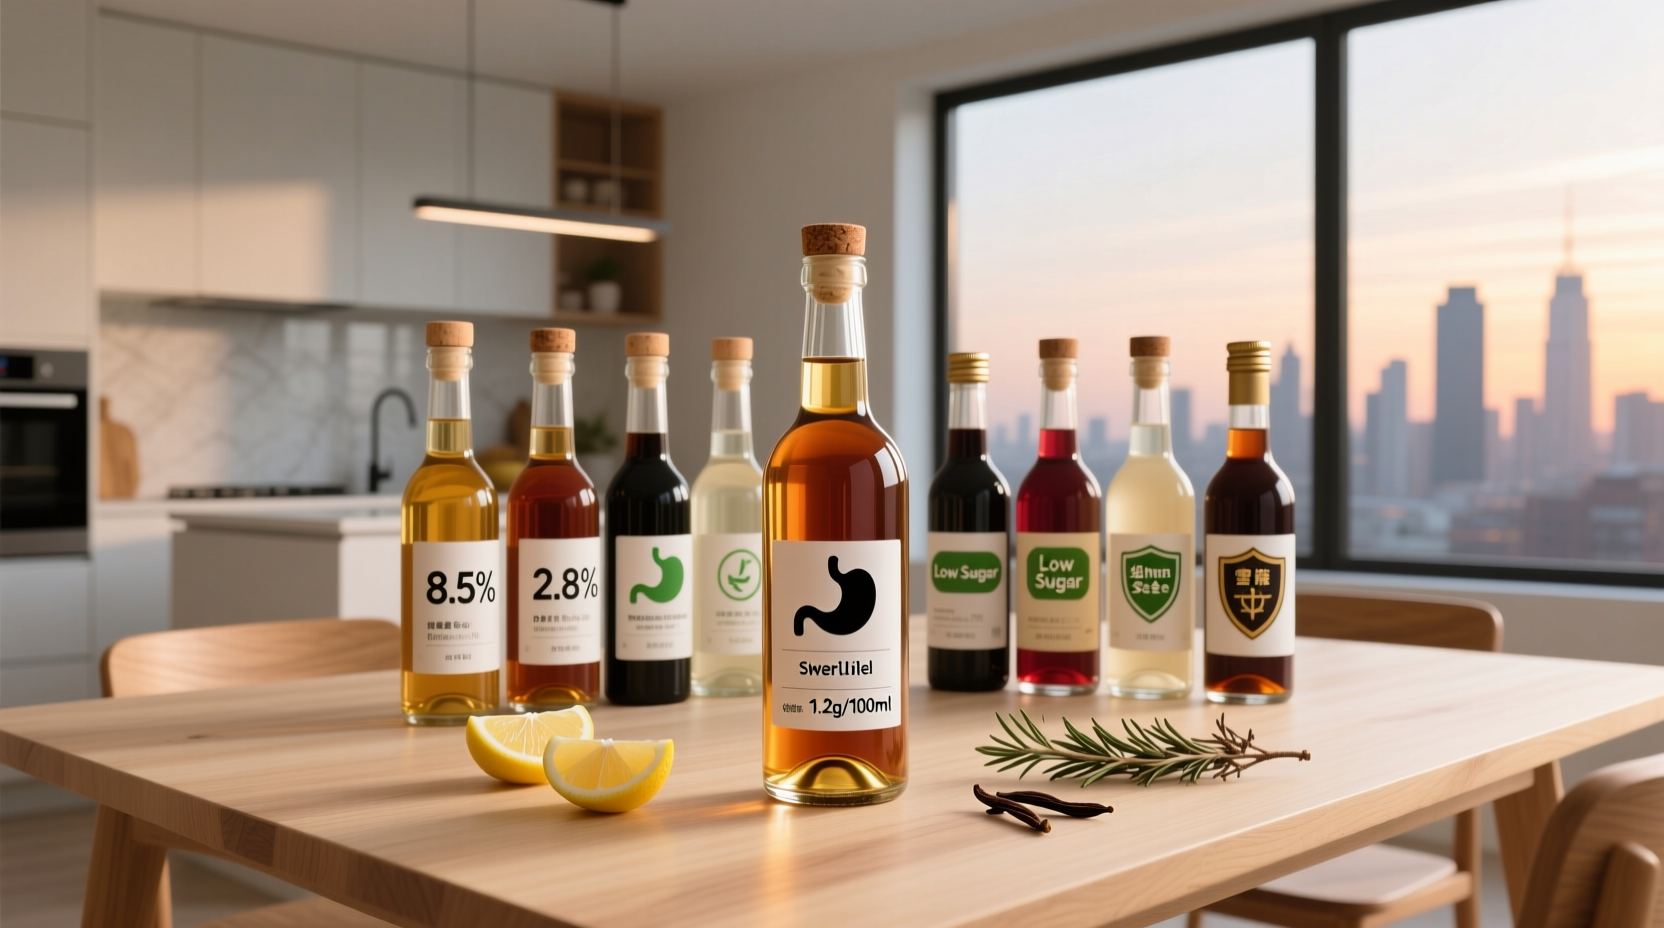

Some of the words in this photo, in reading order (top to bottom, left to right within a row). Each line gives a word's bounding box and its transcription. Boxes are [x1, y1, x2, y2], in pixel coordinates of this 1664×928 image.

[934, 564, 958, 579] Low
[960, 565, 999, 583] Sugar
[1039, 554, 1075, 572] Low
[426, 570, 496, 605] 8.5%
[533, 566, 598, 600] 2.8%
[1034, 573, 1084, 594] Sugar
[808, 695, 892, 719] 1.2g/100ml
